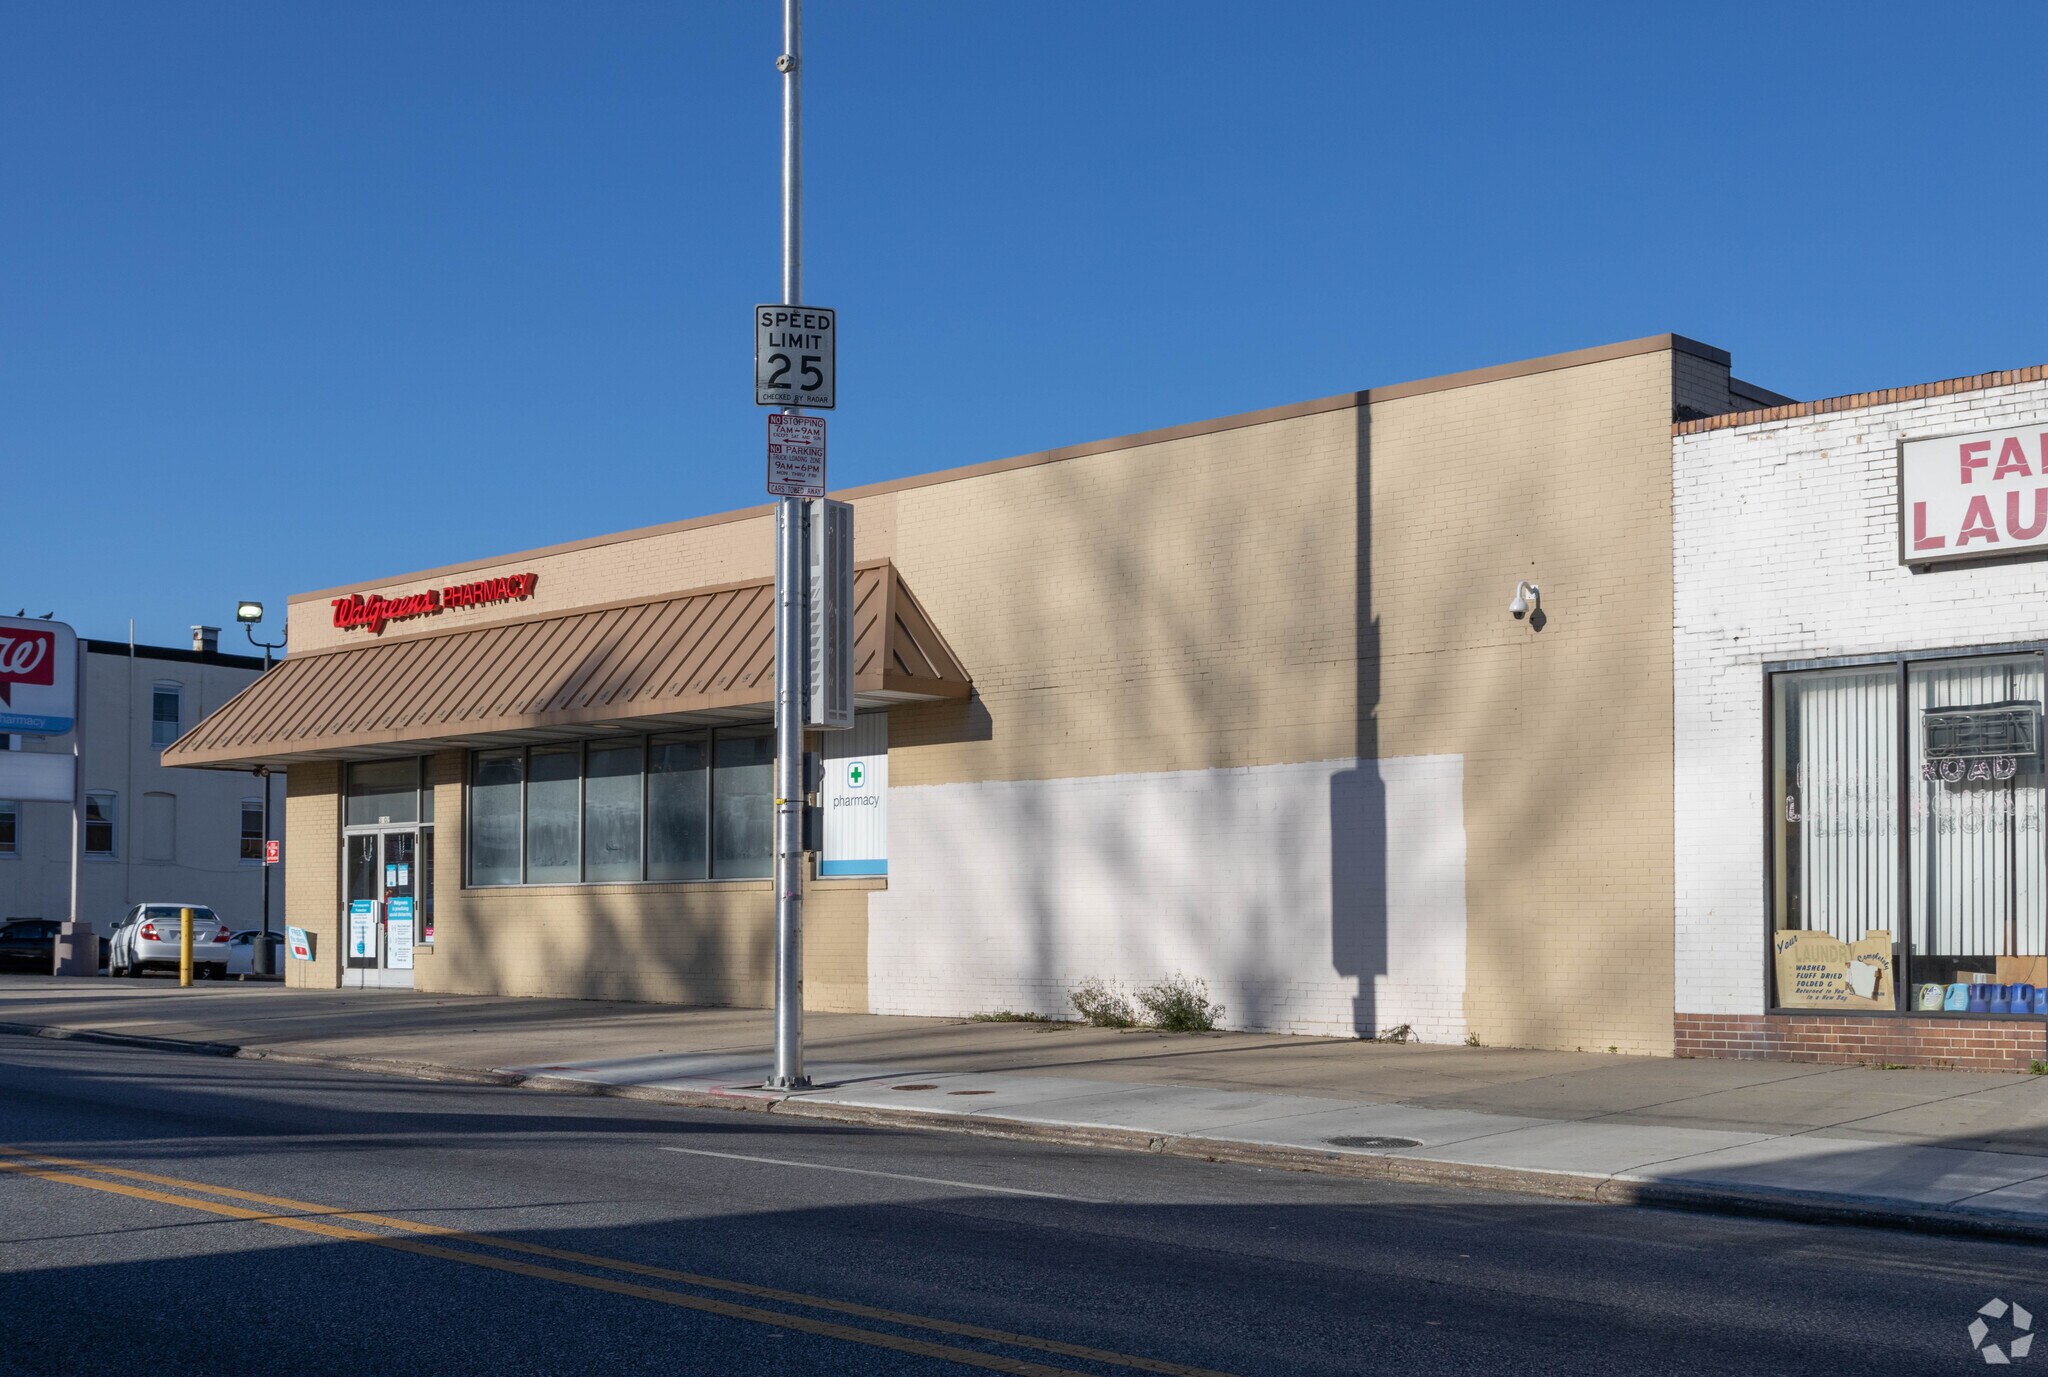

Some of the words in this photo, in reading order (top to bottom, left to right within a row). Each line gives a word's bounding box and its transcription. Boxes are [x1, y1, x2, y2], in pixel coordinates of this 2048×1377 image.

[761, 312, 830, 330] SPEED
[769, 333, 822, 350] LIMIT
[767, 353, 824, 391] 25
[763, 393, 791, 401] CHECKED
[794, 394, 803, 402] BY
[806, 395, 829, 403] RADAR
[770, 415, 782, 424] NO
[783, 416, 824, 427] STOPPING
[770, 445, 782, 453] NO
[785, 446, 823, 457] PARKING
[331, 593, 440, 634] Walgreens
[443, 572, 537, 609] PHARMACY
[1923, 711, 2034, 755] OPEN
[833, 794, 880, 810] pharmacy
[1777, 935, 1799, 954] Your
[1794, 944, 1857, 963] LAUNDRY
[1795, 964, 1826, 972] WASHED
[1857, 952, 1890, 971] Completely
